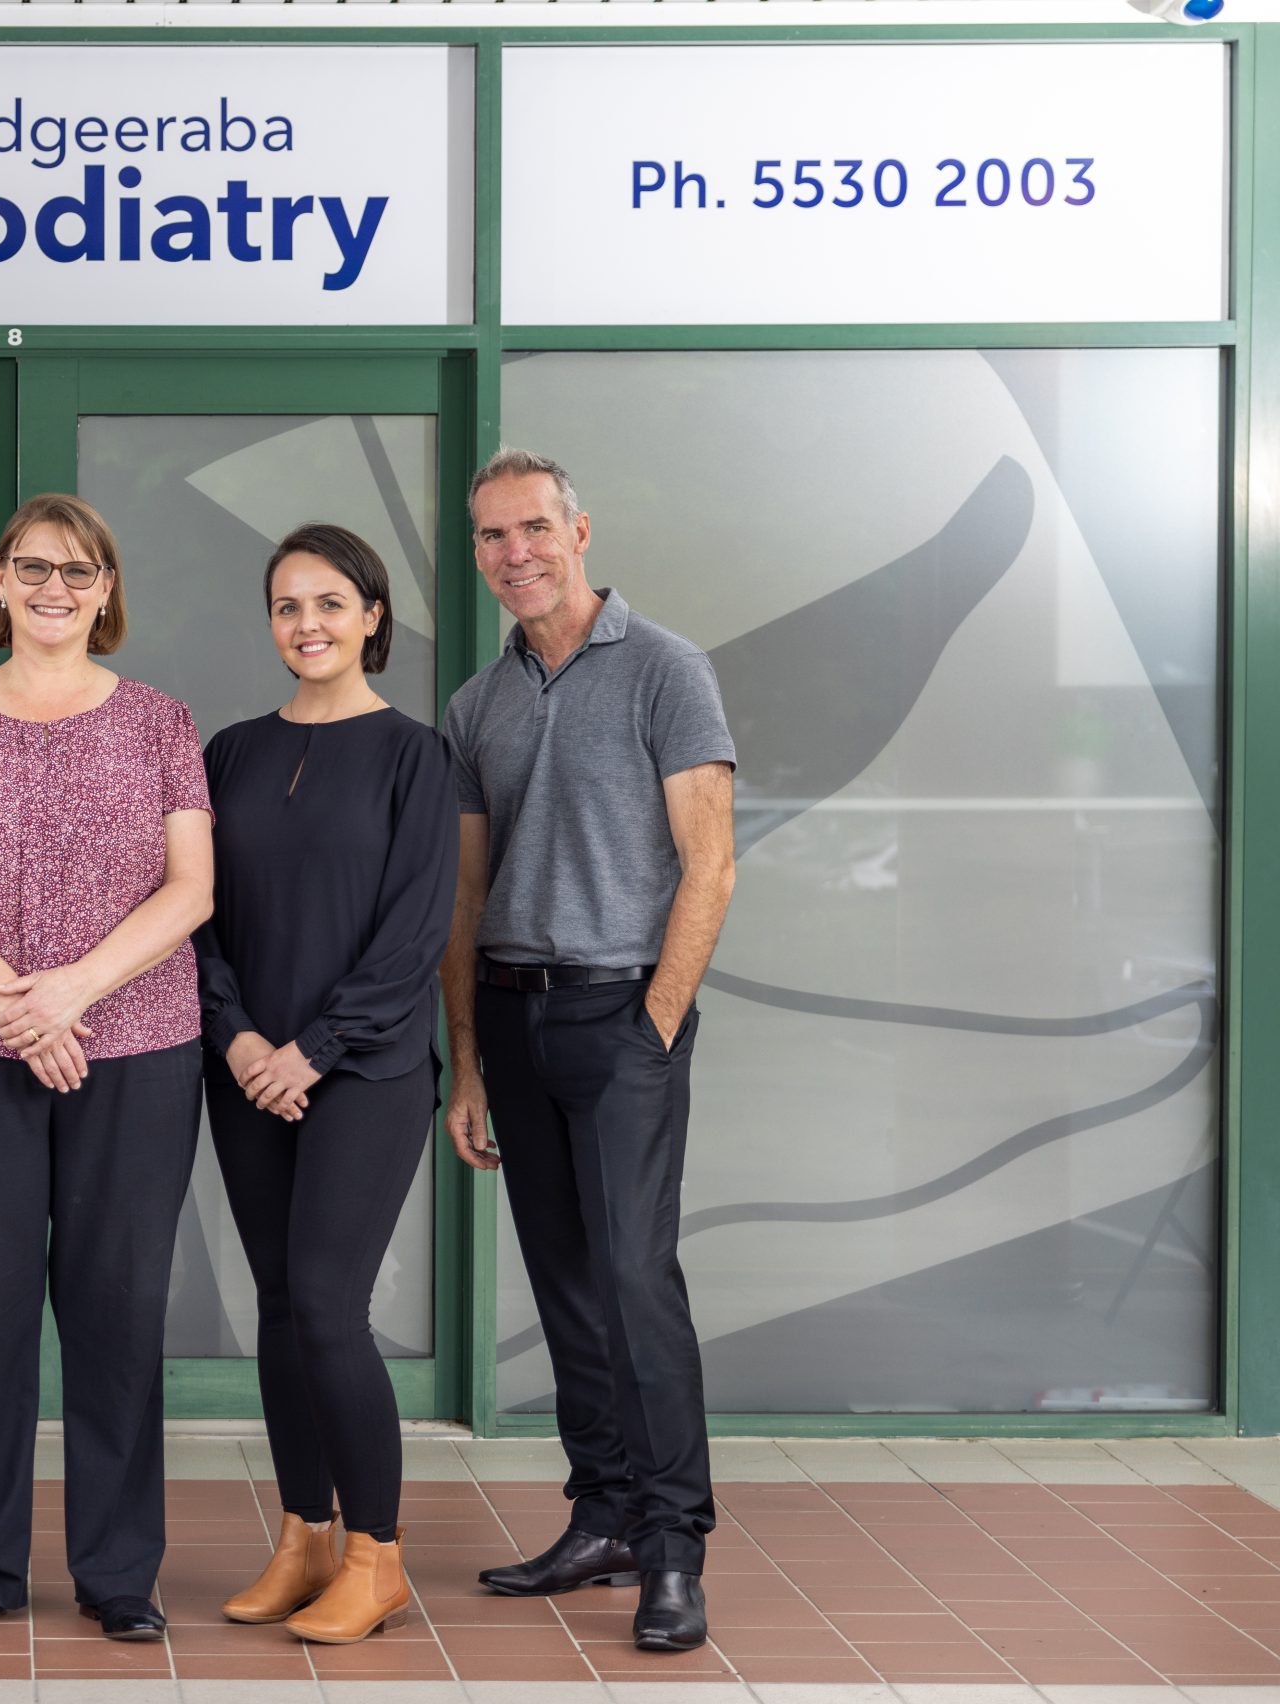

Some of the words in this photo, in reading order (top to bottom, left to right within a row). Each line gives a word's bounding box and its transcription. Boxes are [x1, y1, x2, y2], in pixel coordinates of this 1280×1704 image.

[632, 160, 725, 208] Ph.
[753, 160, 907, 208] 5530
[935, 159, 1095, 208] 2003
[7, 328, 23, 346] 8
